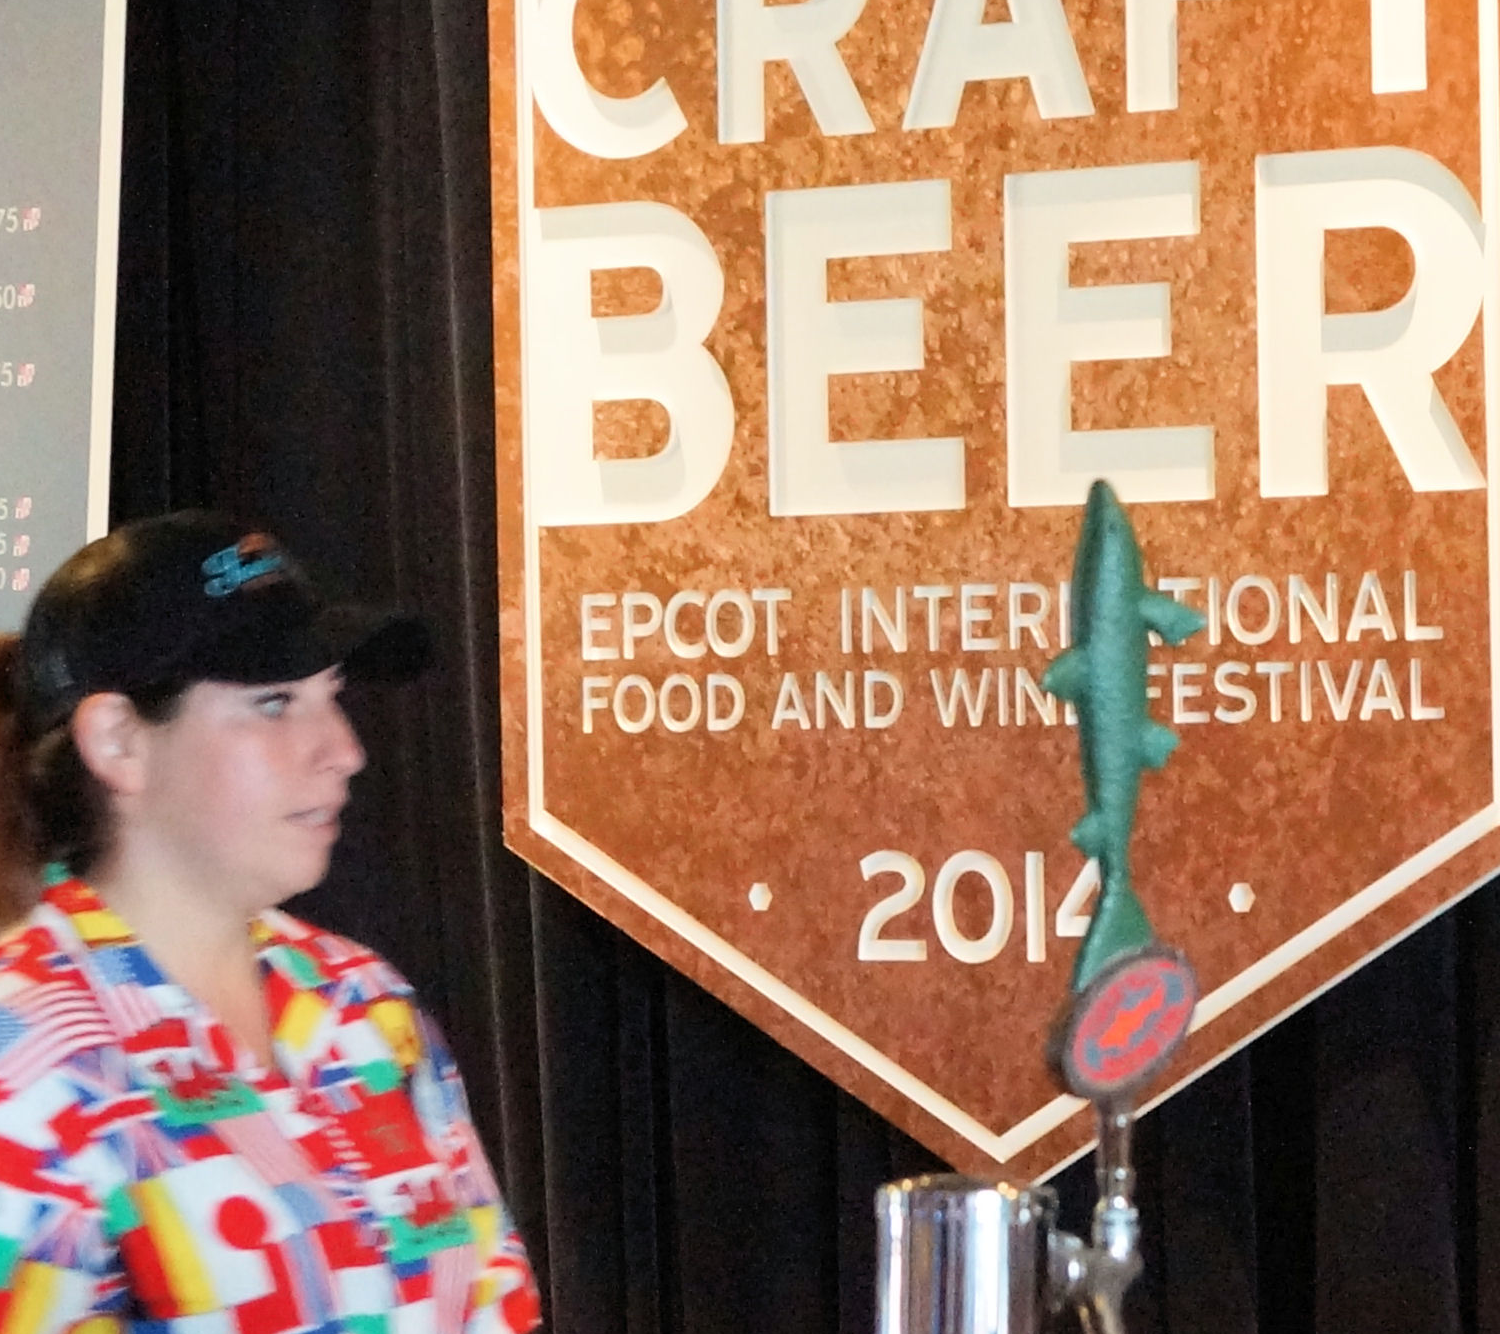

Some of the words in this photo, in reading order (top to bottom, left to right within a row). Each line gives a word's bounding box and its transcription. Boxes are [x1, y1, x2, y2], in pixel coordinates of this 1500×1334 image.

[536, 144, 1489, 527] BEER
[580, 588, 791, 661] EPCOT
[841, 572, 1443, 653] INTERTIONAL
[582, 673, 745, 734] FOOD
[771, 670, 903, 730] AND
